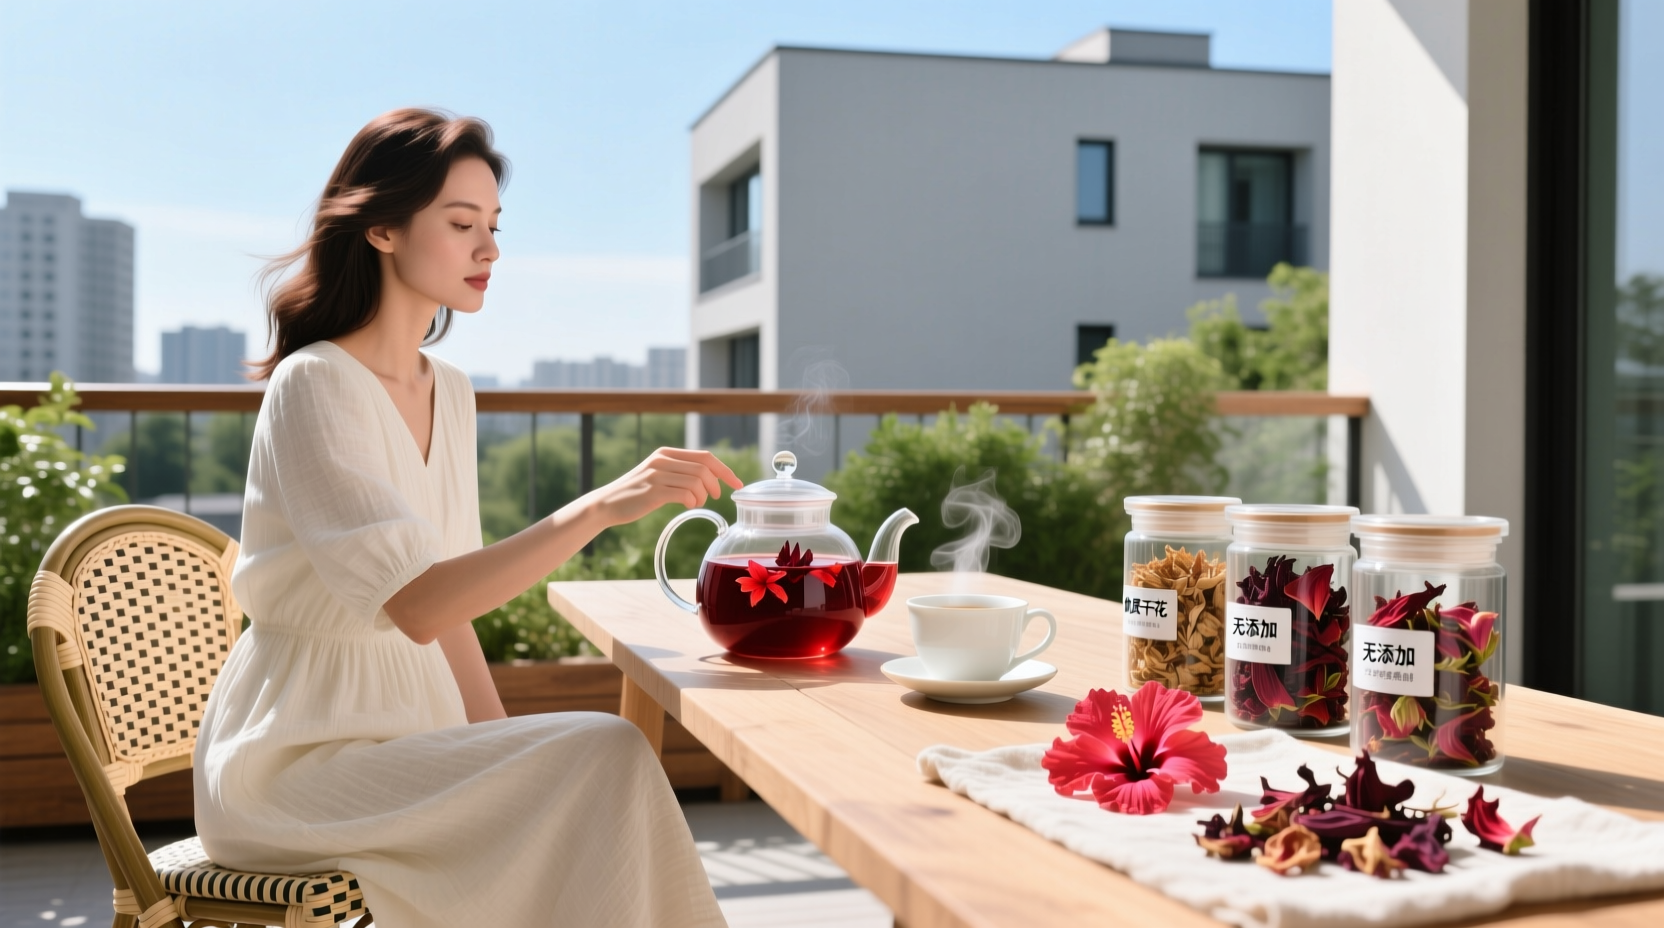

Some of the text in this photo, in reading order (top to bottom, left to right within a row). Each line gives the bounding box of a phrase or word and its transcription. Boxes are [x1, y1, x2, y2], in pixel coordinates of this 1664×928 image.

[1233, 617, 1277, 638] 无添加
[1363, 642, 1415, 666] 无添加
